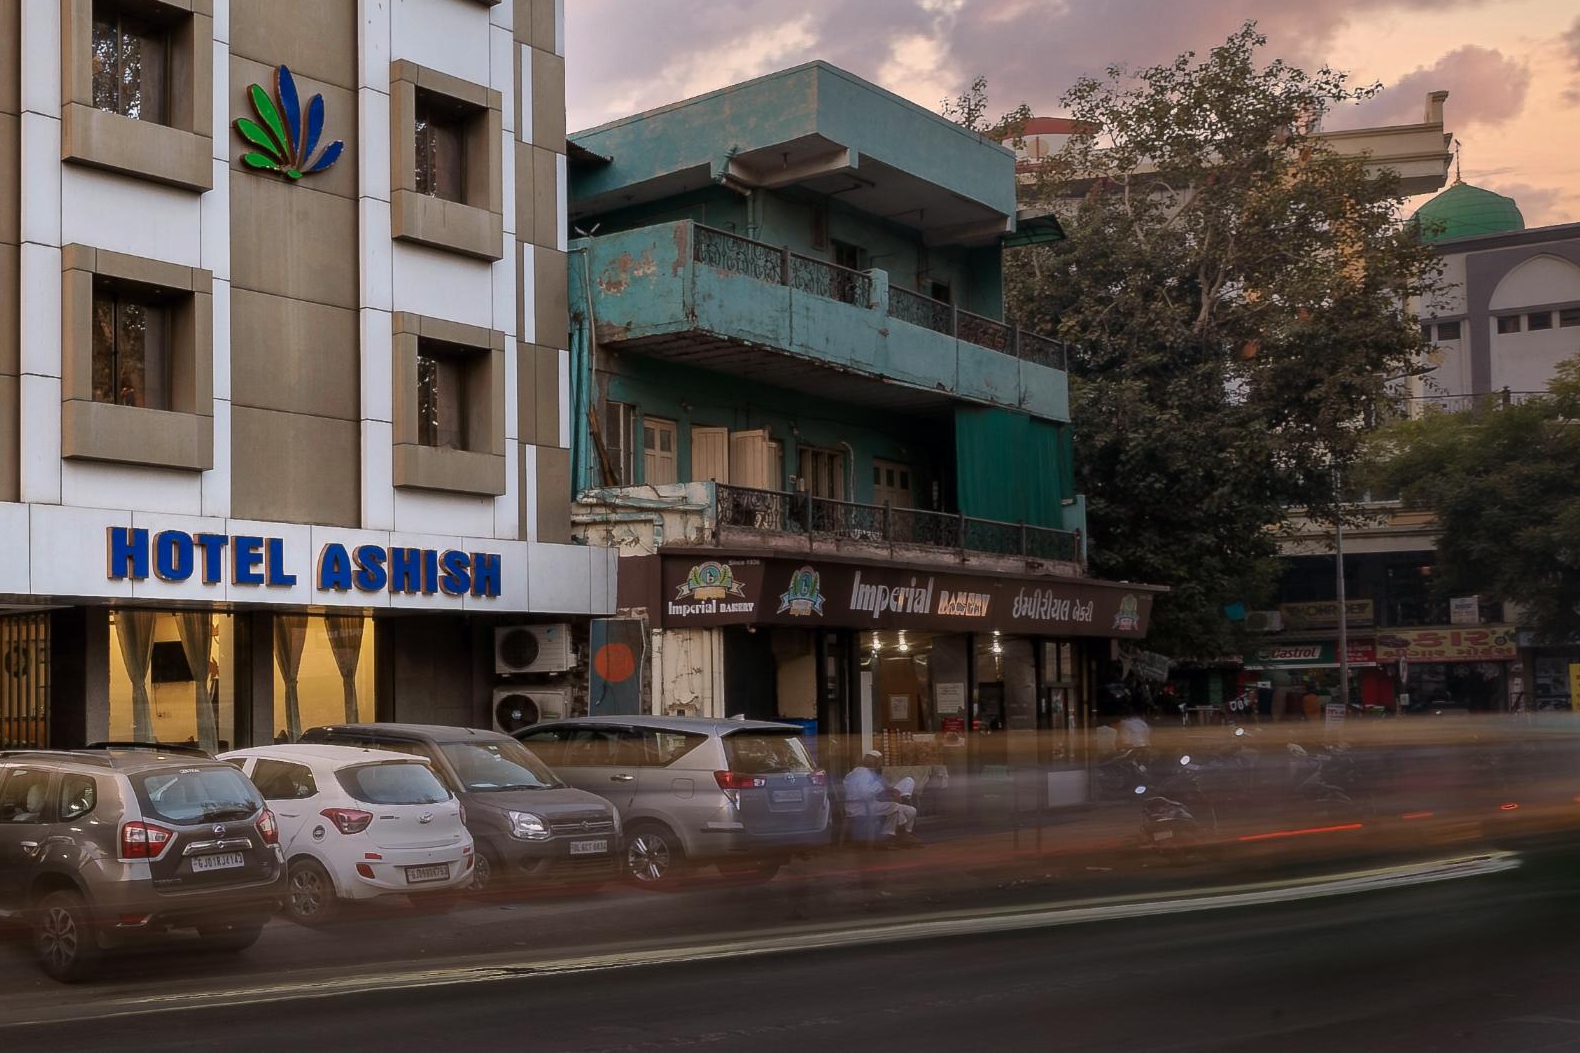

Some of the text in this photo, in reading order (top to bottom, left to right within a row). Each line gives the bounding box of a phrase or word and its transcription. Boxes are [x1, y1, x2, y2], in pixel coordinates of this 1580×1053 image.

[106, 526, 502, 597] HOTEL ASHISH
[668, 599, 717, 617] Imperial
[850, 570, 935, 619] Imperial
